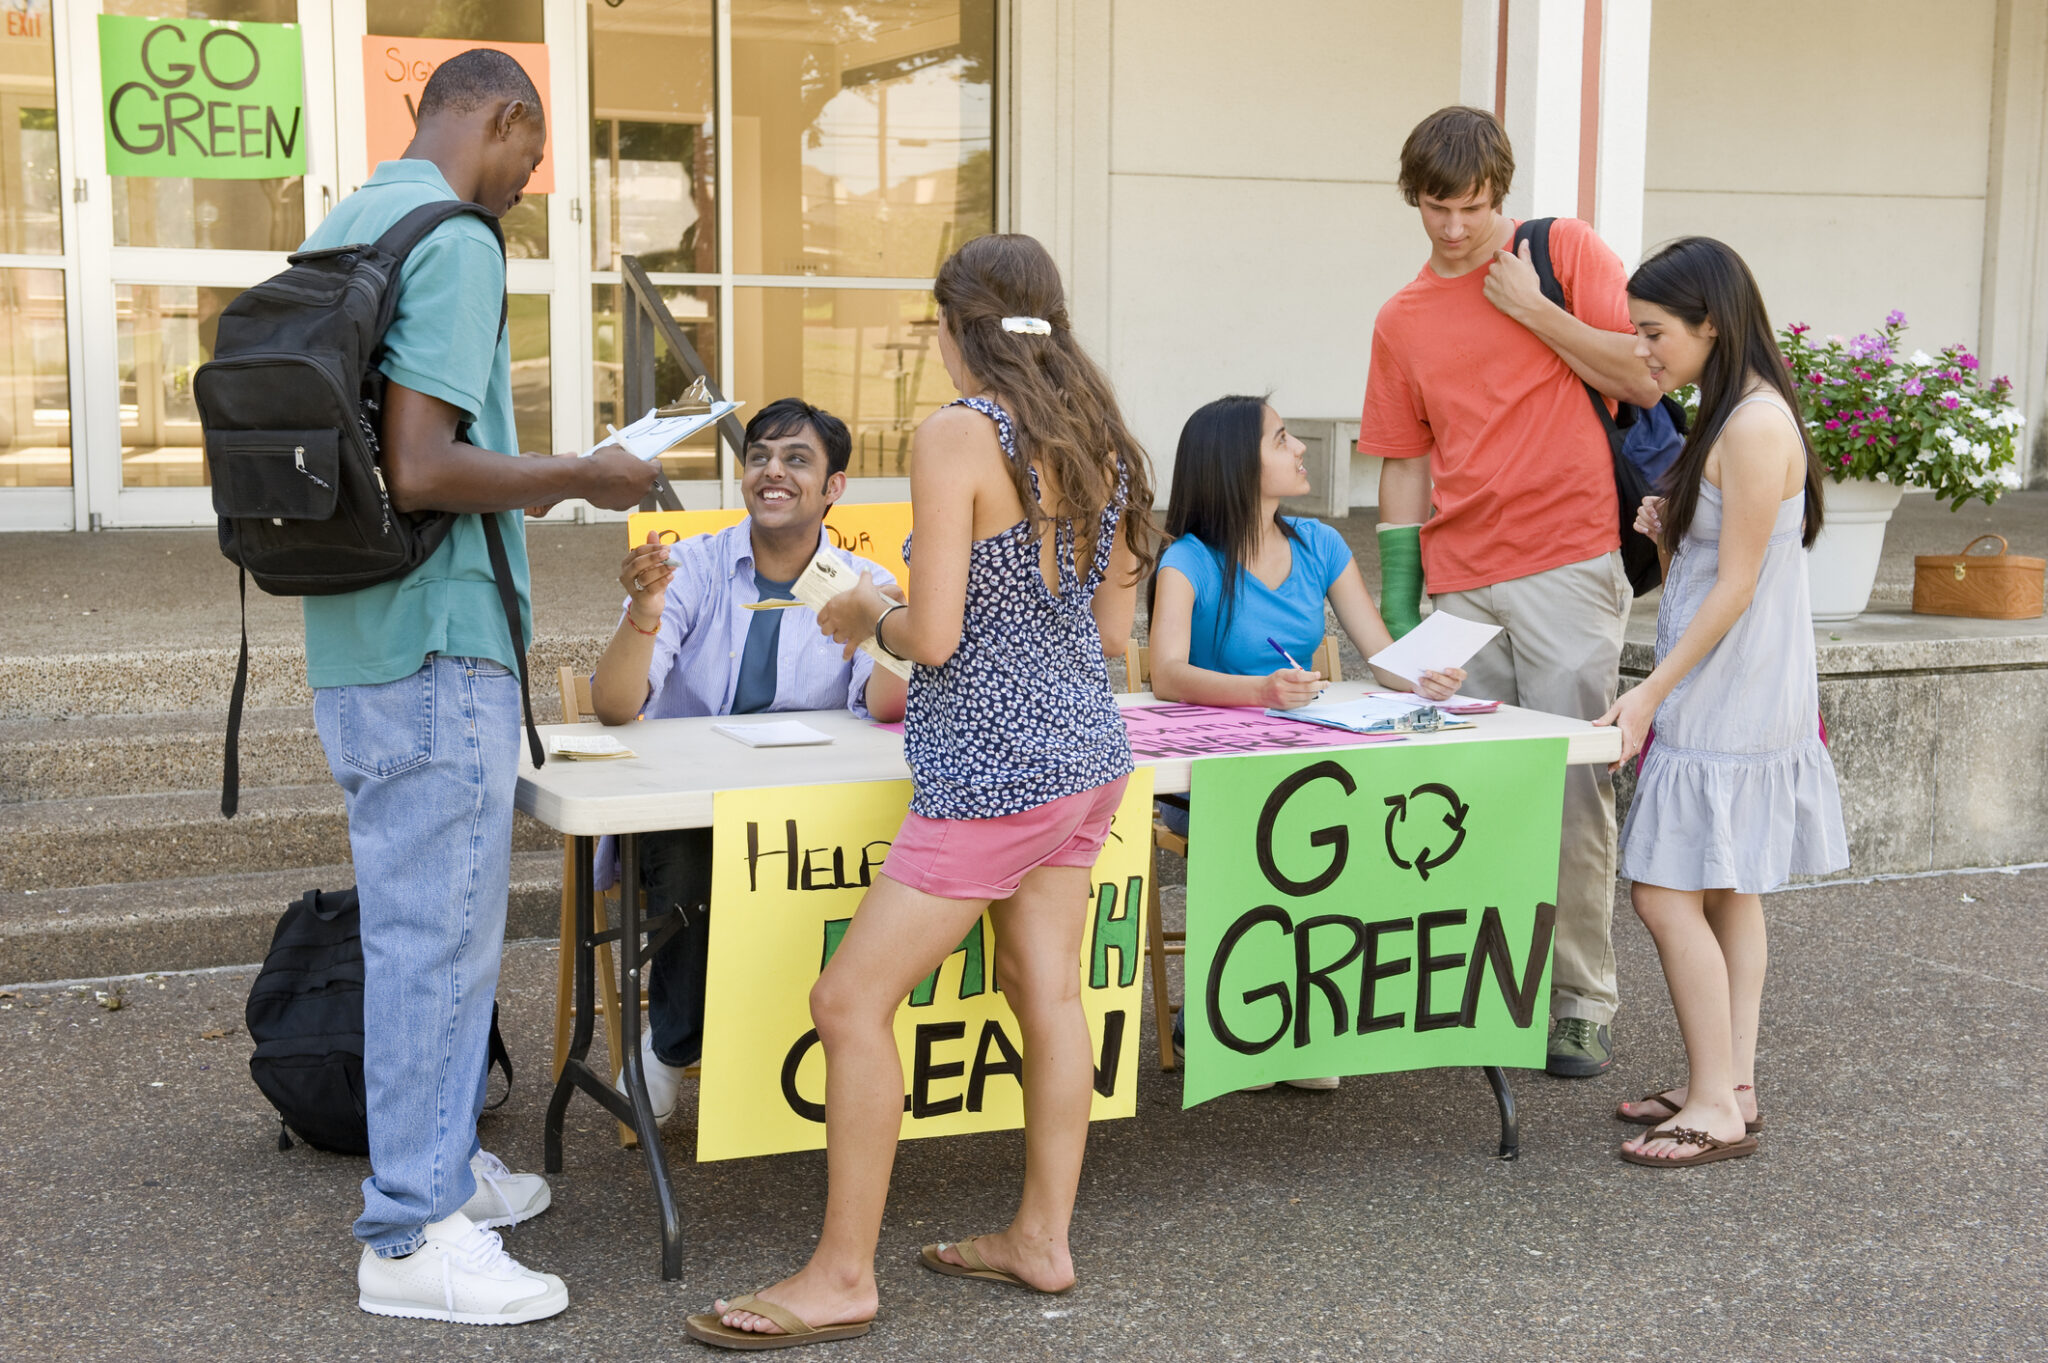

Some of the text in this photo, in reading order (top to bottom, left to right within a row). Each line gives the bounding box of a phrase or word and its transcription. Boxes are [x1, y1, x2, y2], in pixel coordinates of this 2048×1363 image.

[7, 11, 42, 38] EXIT
[141, 24, 260, 91] GO
[384, 47, 435, 83] SIG
[109, 81, 301, 159] GREEN
[1120, 705, 1224, 722] TE
[1133, 738, 1330, 758] HERE
[744, 819, 893, 892] HELP
[1206, 902, 1557, 1056] GREEN
[781, 1010, 1126, 1123] CEAN
